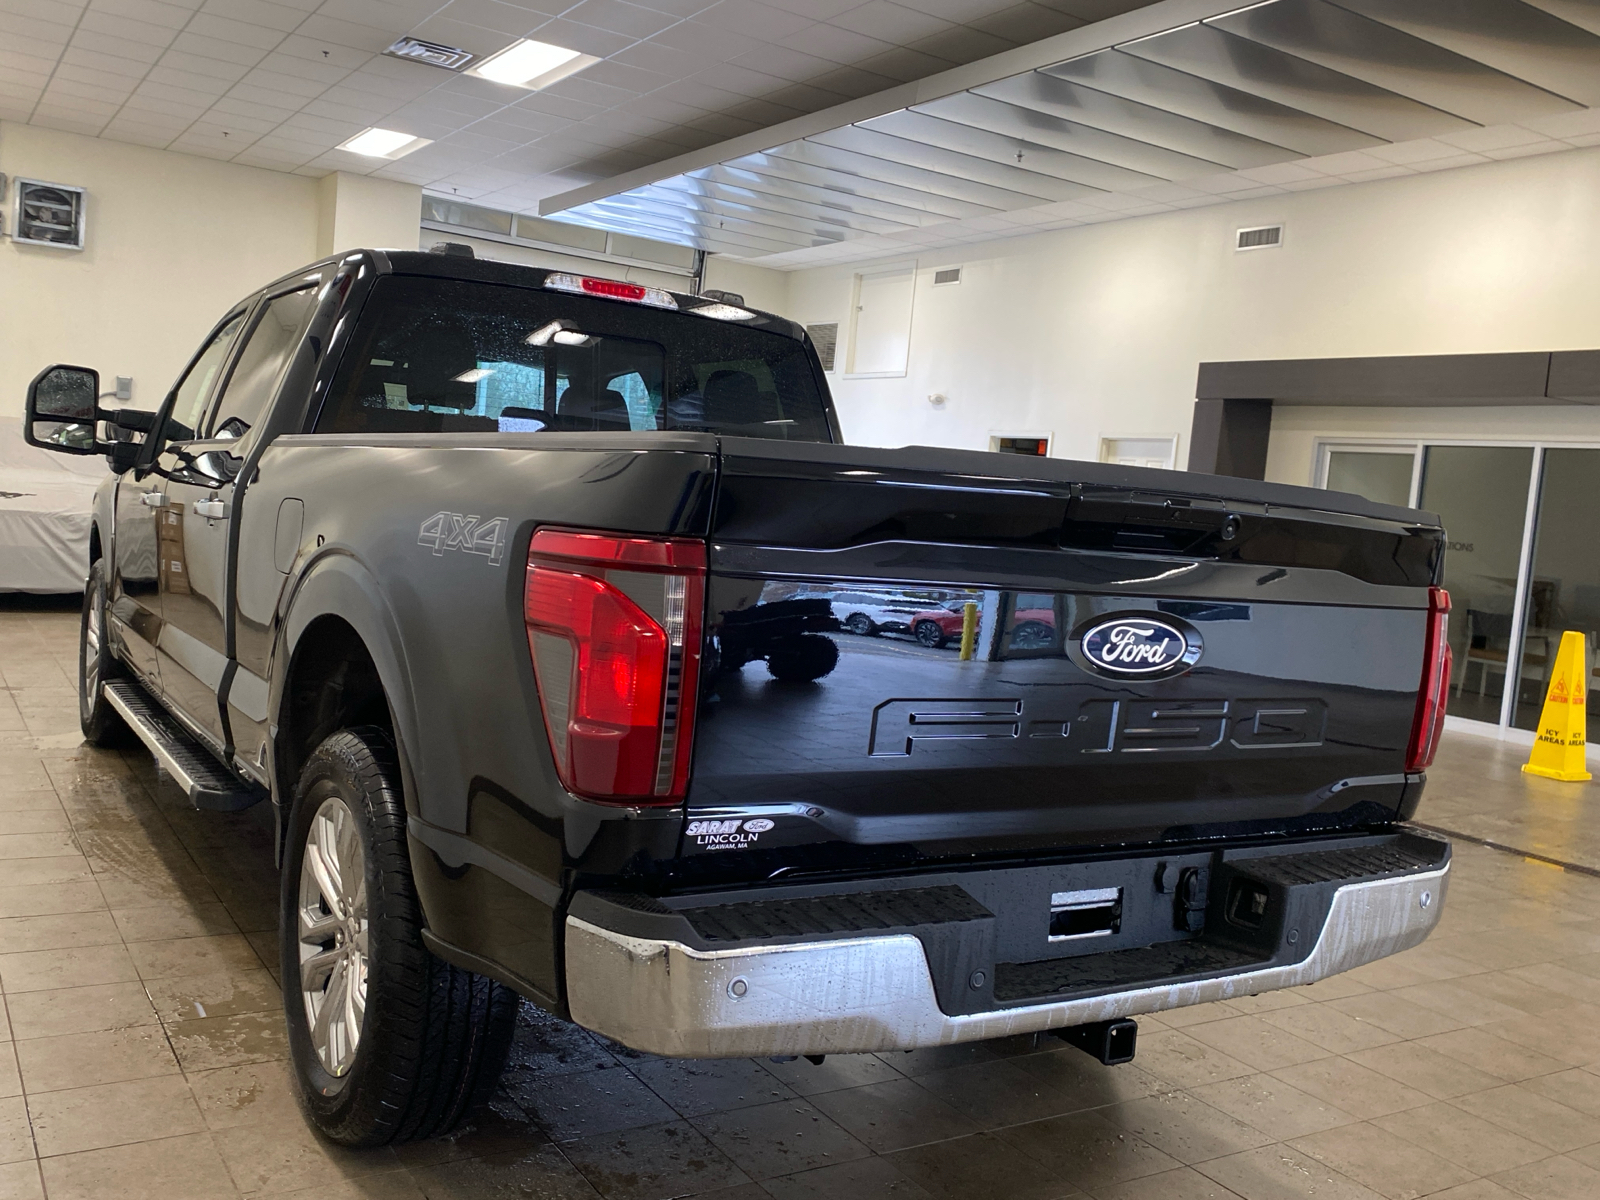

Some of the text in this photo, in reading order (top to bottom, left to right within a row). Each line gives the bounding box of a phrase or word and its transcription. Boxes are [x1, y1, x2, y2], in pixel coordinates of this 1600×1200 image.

[1102, 625, 1170, 663] Ford
[867, 697, 1329, 757] F-150
[1538, 735, 1565, 746] AREAS
[686, 820, 742, 835] SARAT
[697, 833, 758, 844] LINCOLN
